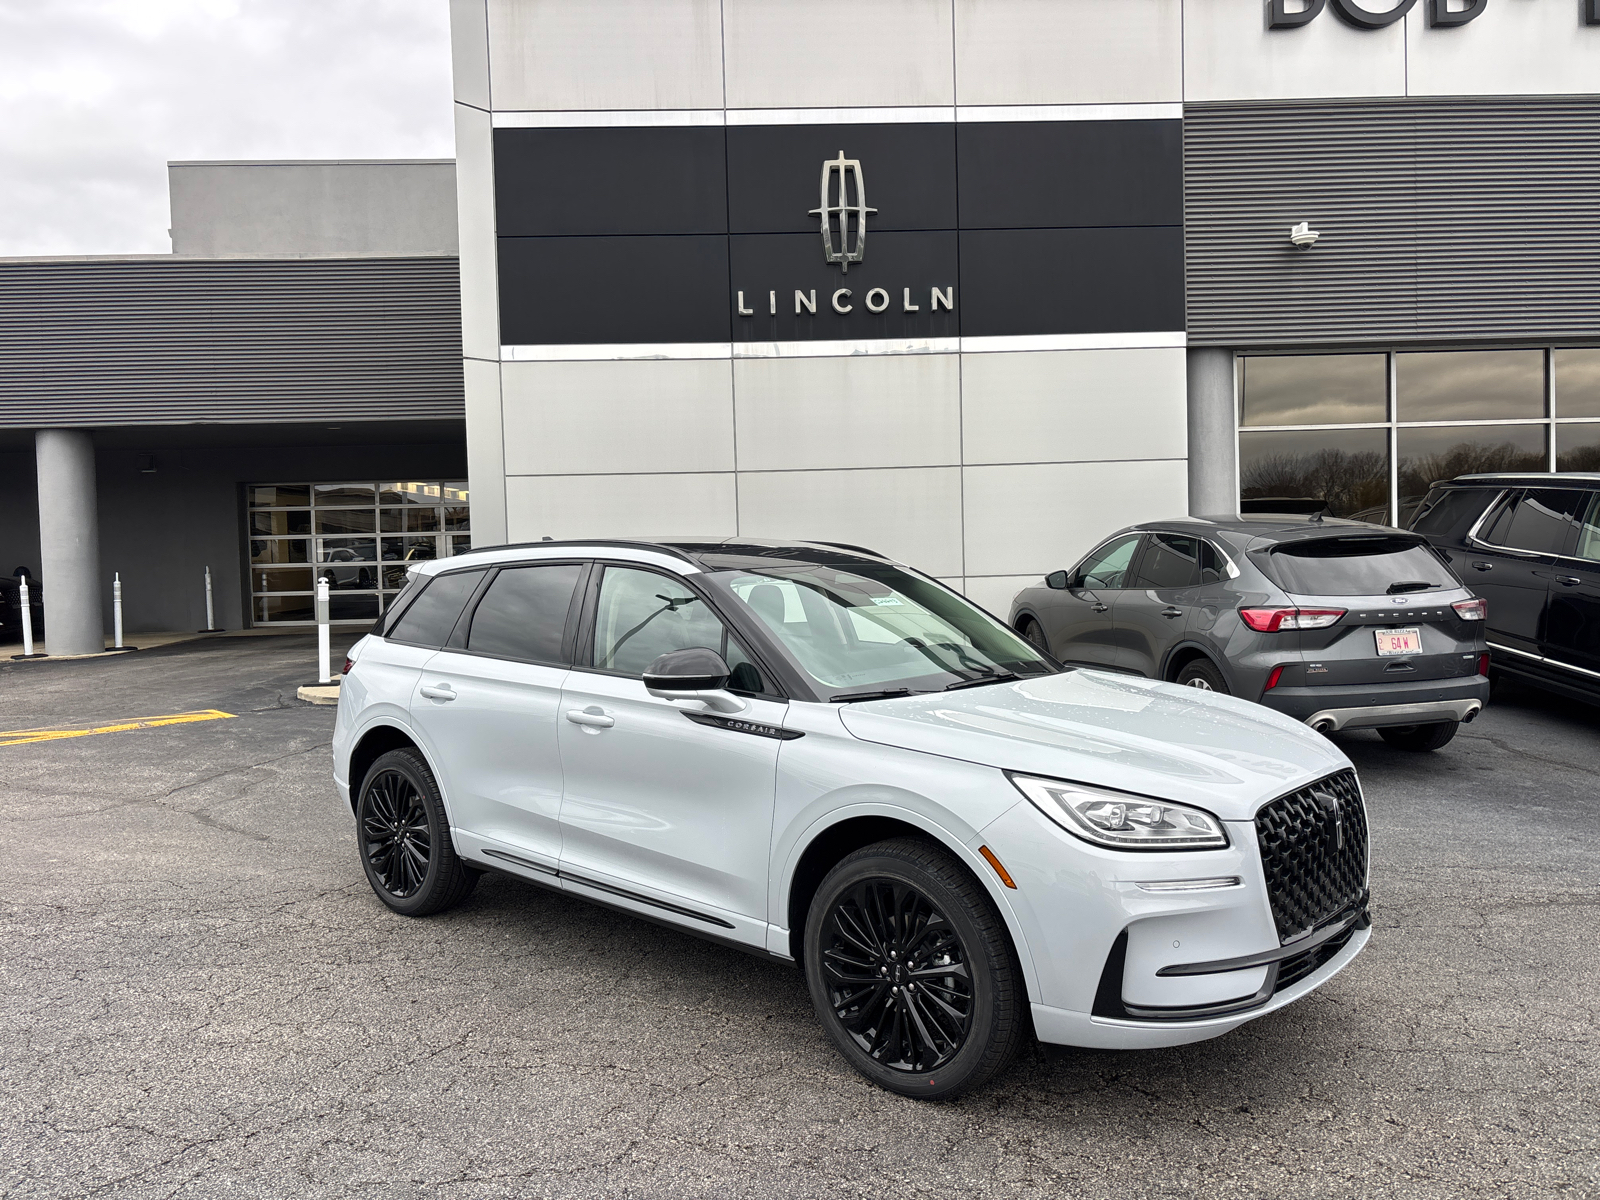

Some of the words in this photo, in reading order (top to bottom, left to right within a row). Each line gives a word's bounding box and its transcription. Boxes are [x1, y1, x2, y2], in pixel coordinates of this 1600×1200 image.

[737, 286, 954, 317] LINCOLN
[1391, 637, 1402, 649] 64
[727, 720, 776, 735] CORSAIR
